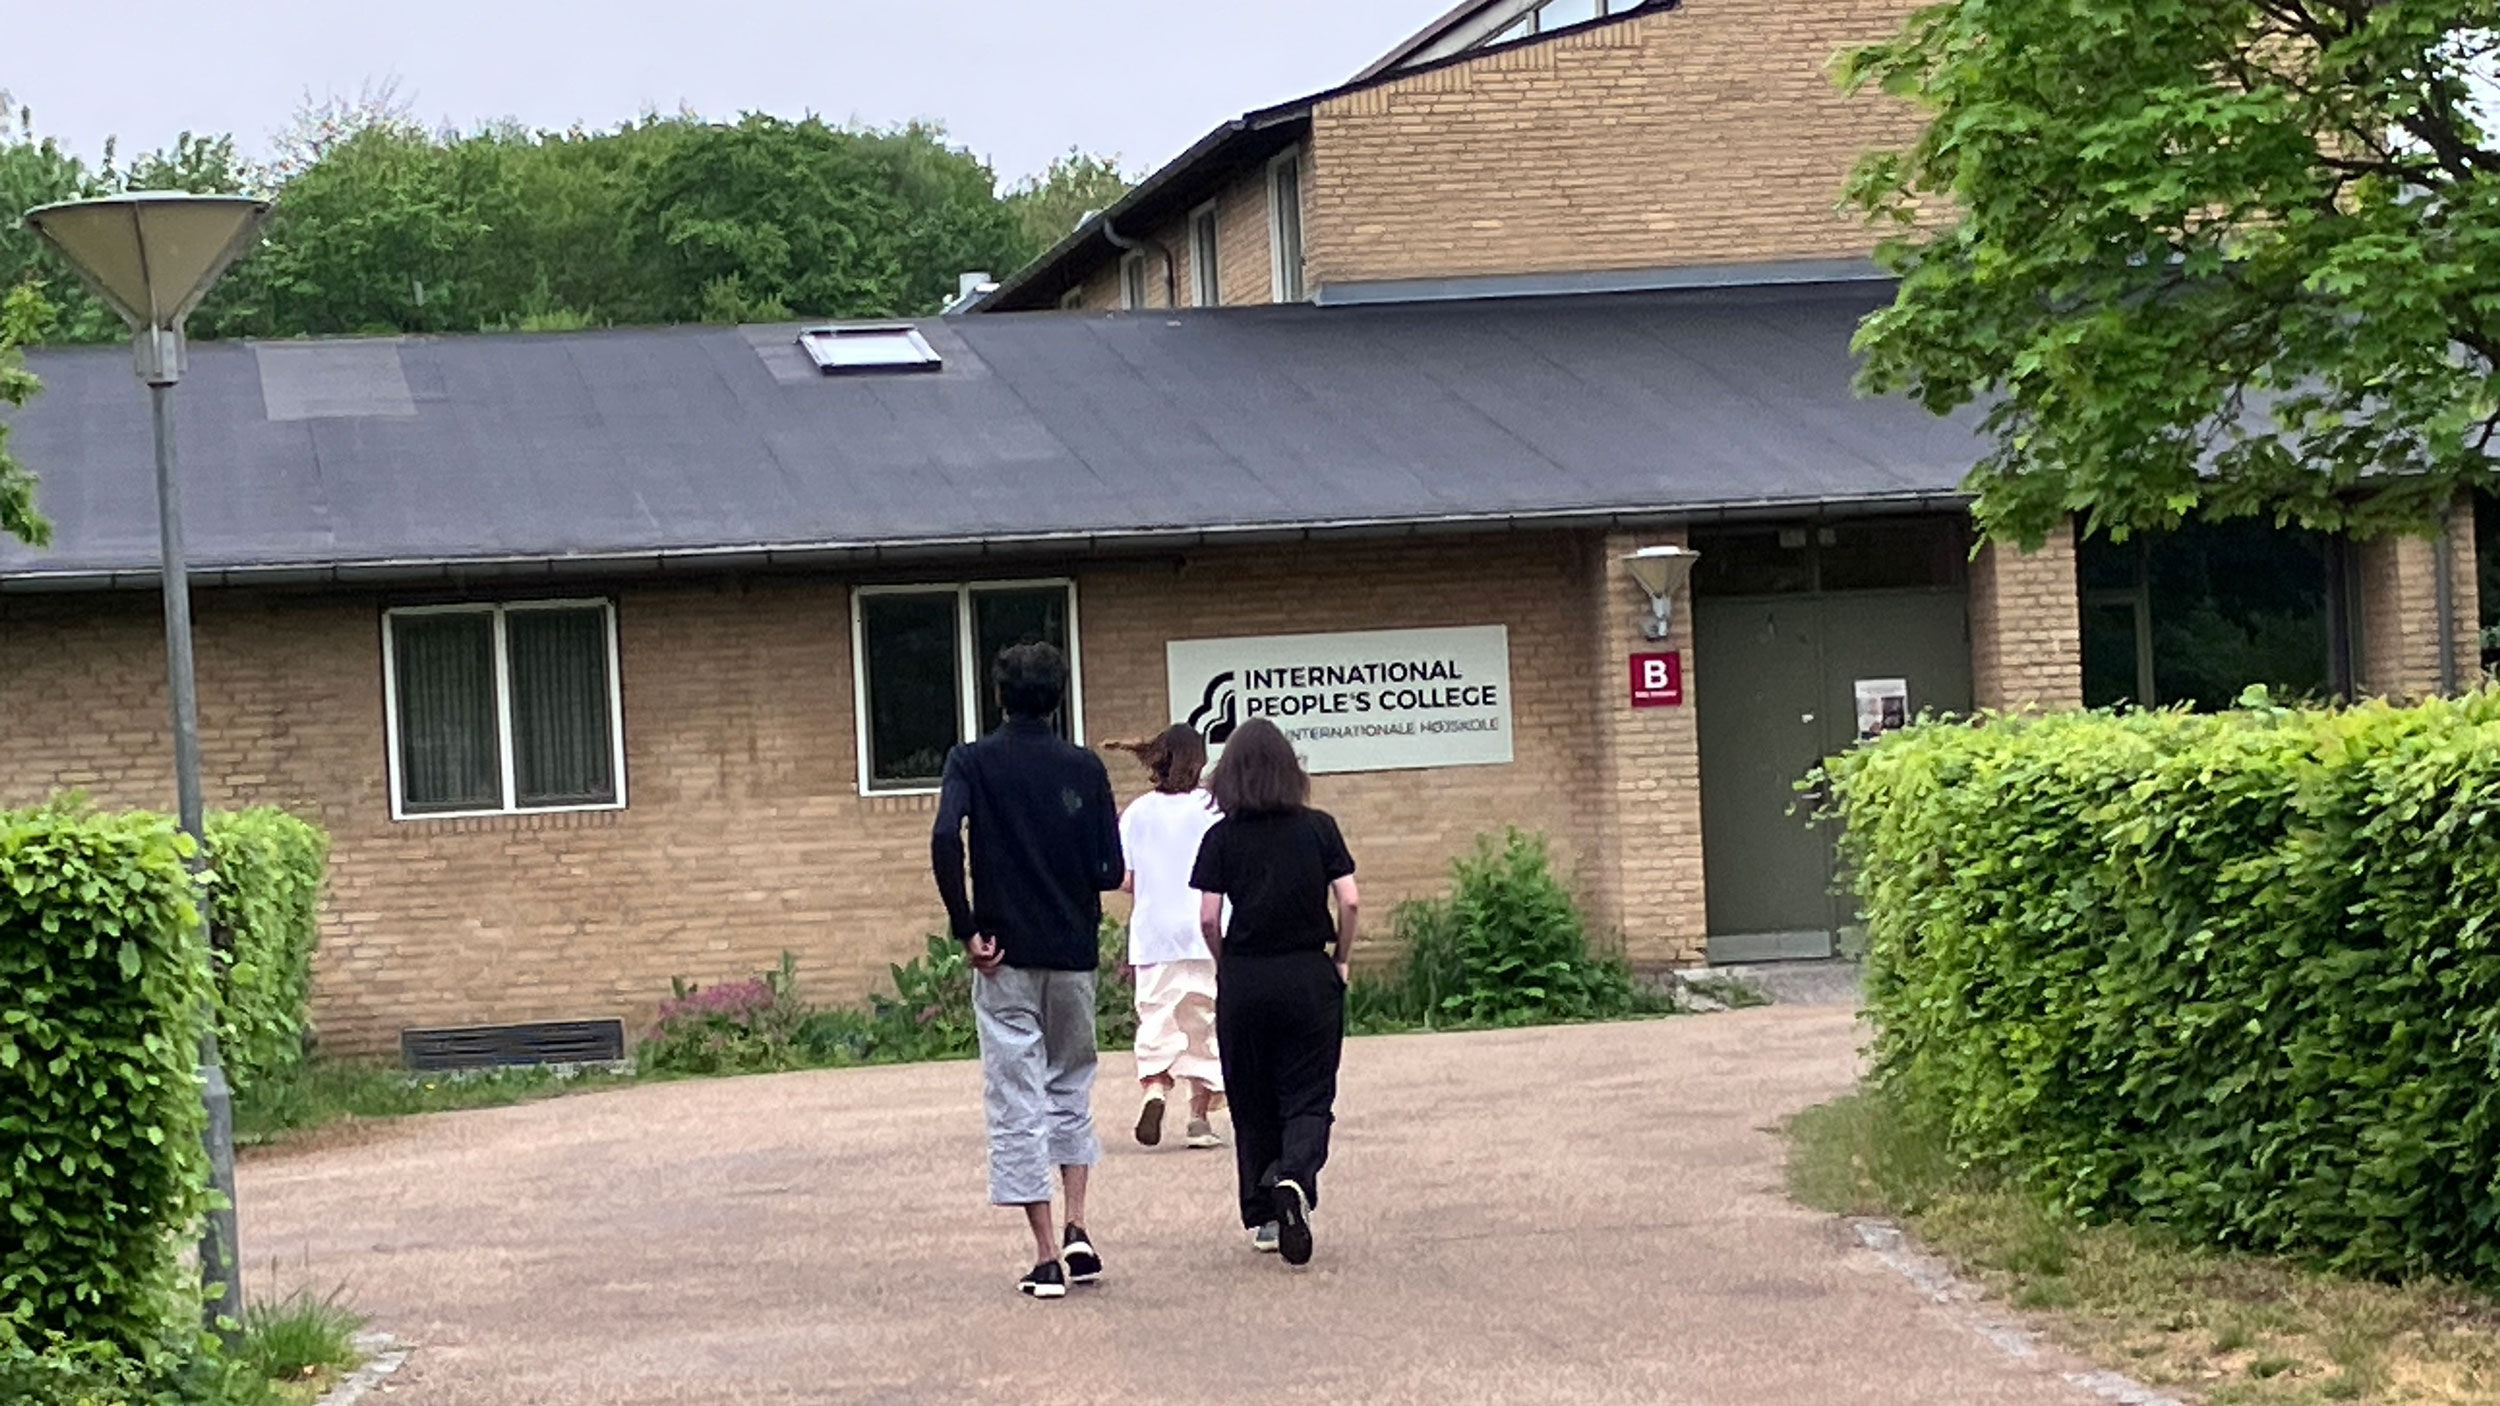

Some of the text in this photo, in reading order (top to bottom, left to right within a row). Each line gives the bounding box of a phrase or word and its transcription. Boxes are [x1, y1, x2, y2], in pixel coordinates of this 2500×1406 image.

[1245, 660, 1462, 690] INTERNATIONAL
[1643, 659, 1669, 689] B
[1247, 685, 1497, 717] PEOPLE'S COLLEGE
